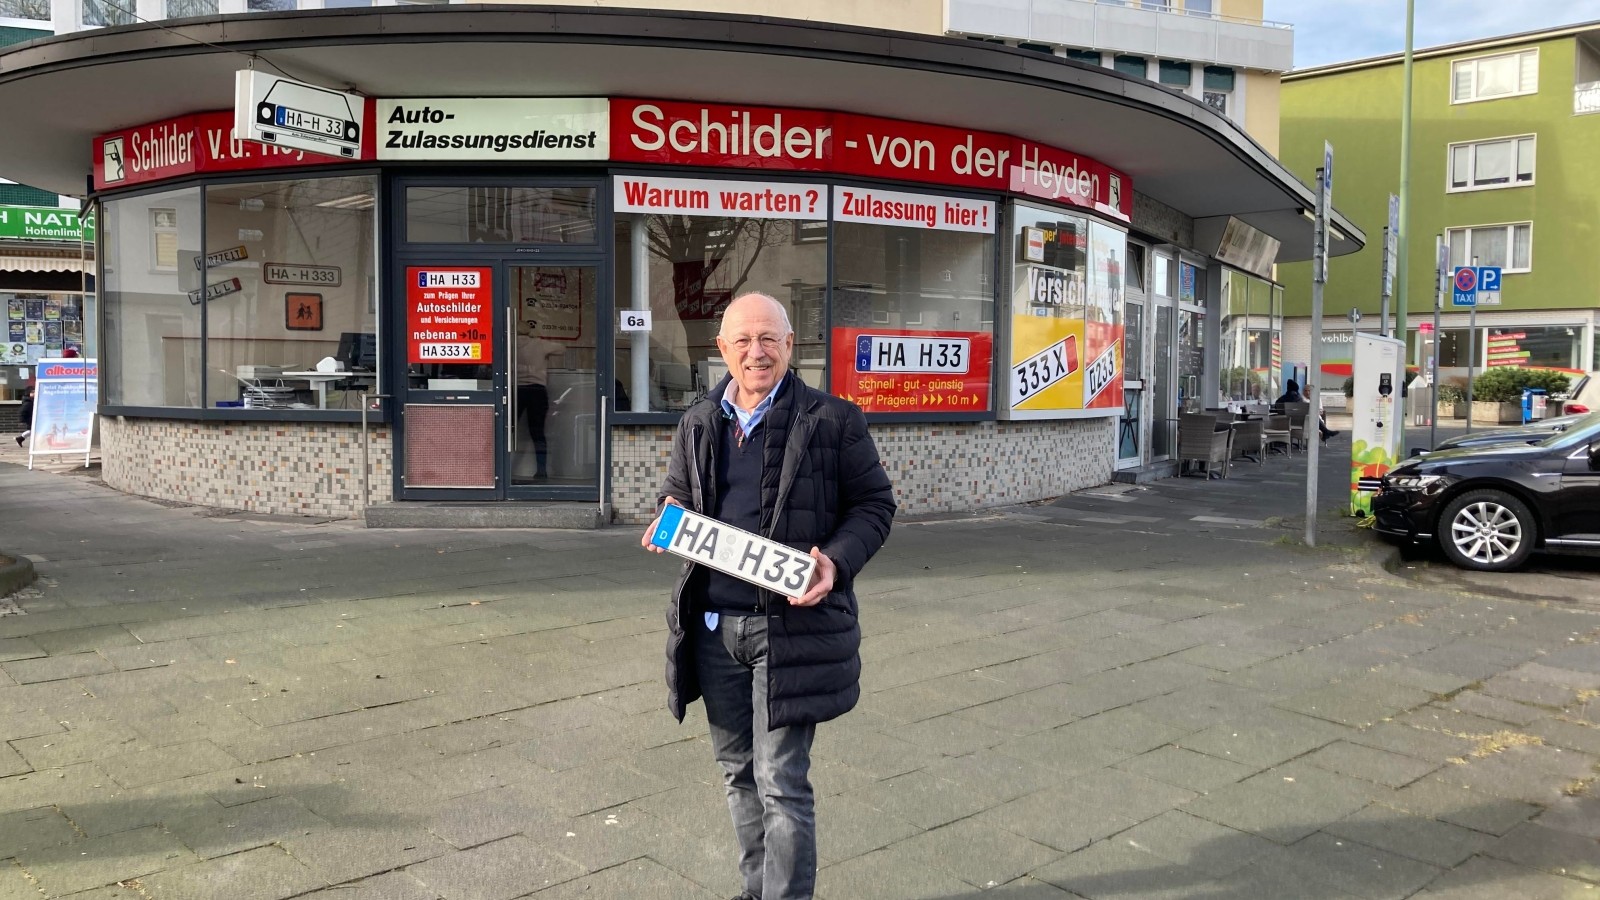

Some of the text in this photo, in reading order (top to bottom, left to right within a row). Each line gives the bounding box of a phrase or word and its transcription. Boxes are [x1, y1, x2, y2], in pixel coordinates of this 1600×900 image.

[388, 105, 455, 123] Auto-
[326, 119, 341, 135] 33
[131, 123, 193, 173] Schilder
[385, 130, 597, 152] Zulassungsdienst
[630, 104, 832, 159] Schilder
[866, 133, 935, 171] von
[951, 135, 1009, 179] der
[1021, 144, 1100, 200] Heyden
[623, 181, 819, 213] Warum warten?
[842, 191, 988, 228] Zulassung hier!
[25, 226, 82, 237] Hohenlimb
[271, 268, 289, 280] HA
[312, 271, 335, 282] 333
[430, 274, 445, 285] HA
[1482, 269, 1496, 290] P
[438, 291, 458, 300] Prägen
[461, 291, 475, 299] Ihrer
[1455, 293, 1475, 303] TAXI
[416, 302, 481, 313] Autoschilder
[434, 315, 478, 325] Versicherungen
[627, 315, 645, 327] 6a
[413, 329, 457, 340] nebenan
[467, 329, 478, 340] 10
[1320, 333, 1354, 343] wohlbe
[422, 346, 437, 356] HA
[440, 346, 460, 356] 333
[463, 346, 470, 356] X
[878, 342, 906, 367] HA
[1053, 345, 1065, 377] X
[45, 364, 85, 376] alltour
[858, 379, 895, 390] schnell
[903, 380, 920, 392] gut
[928, 379, 964, 392] günstig
[856, 394, 969, 408] zur Prägerei 10 m
[659, 530, 668, 540] D
[674, 517, 719, 560] HA
